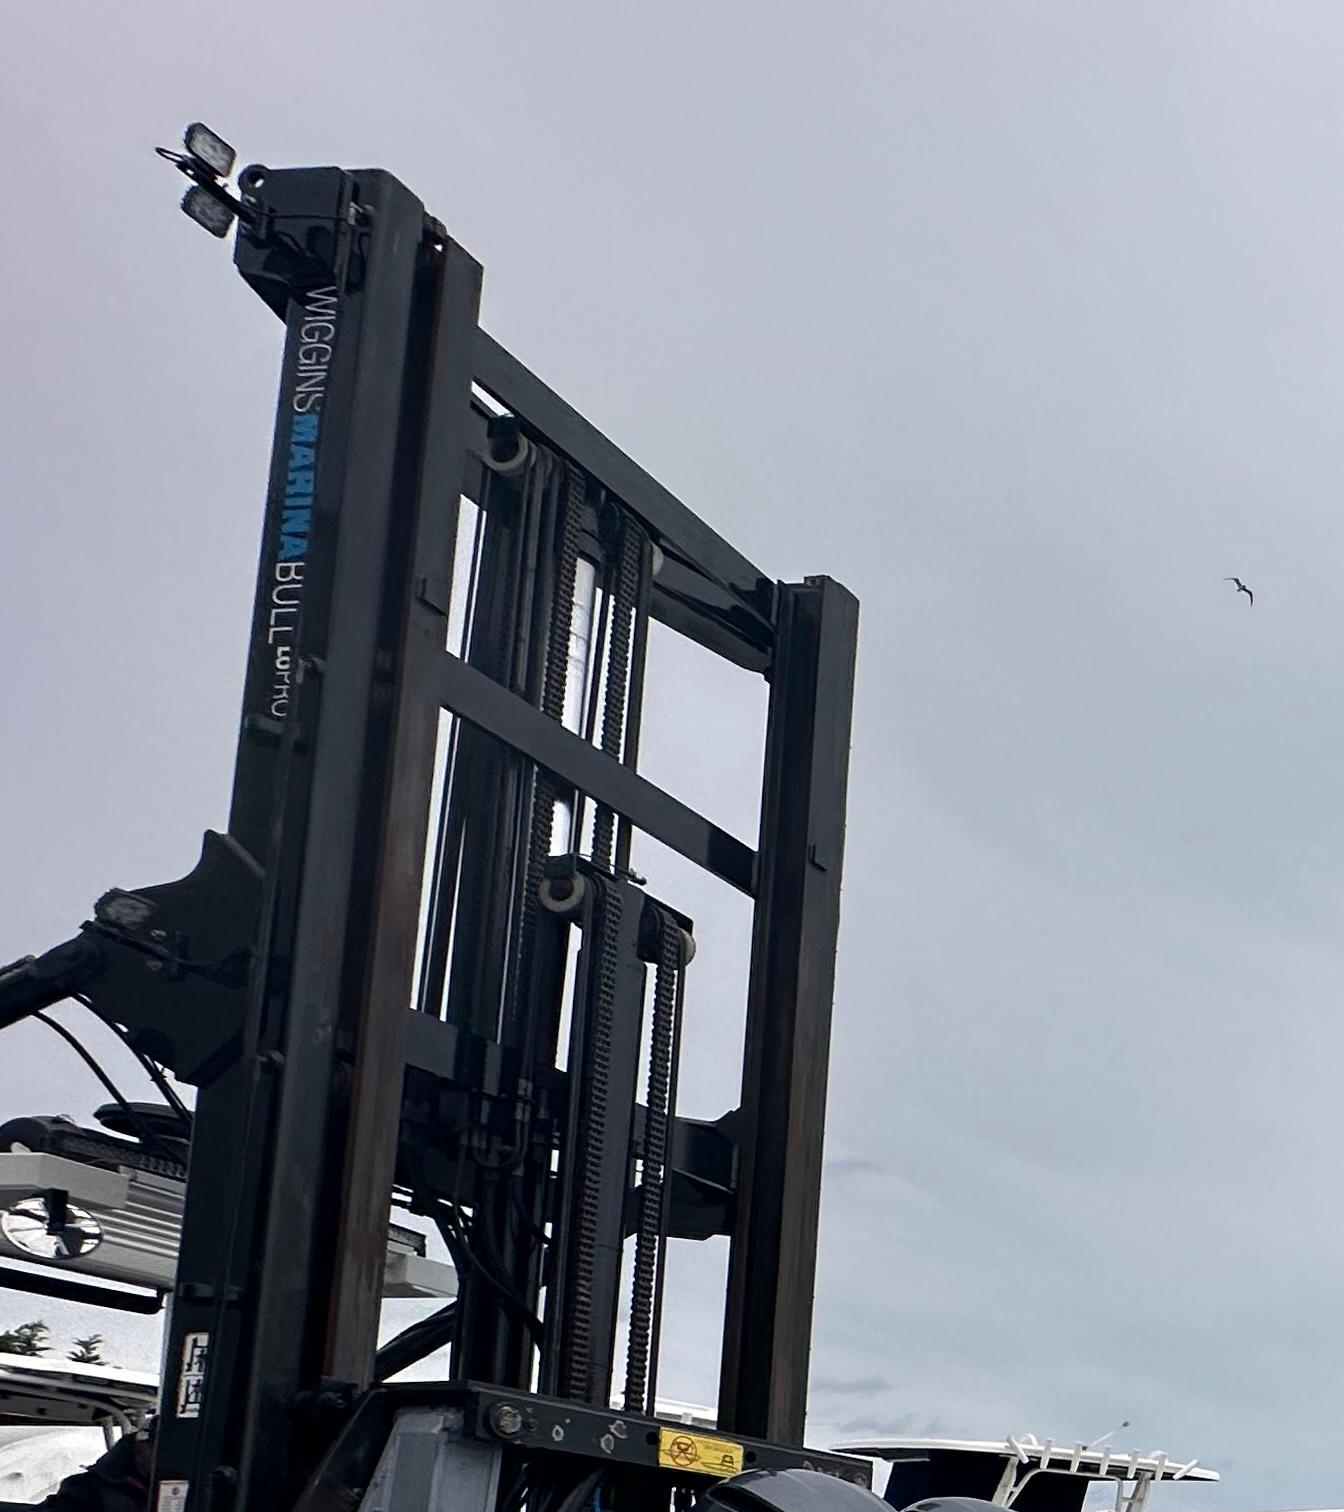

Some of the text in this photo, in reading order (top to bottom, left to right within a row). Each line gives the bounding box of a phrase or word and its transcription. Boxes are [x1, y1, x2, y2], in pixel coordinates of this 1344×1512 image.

[293, 285, 339, 412] WIGGINS
[278, 413, 320, 561] MARINA
[267, 561, 306, 645] BULL
